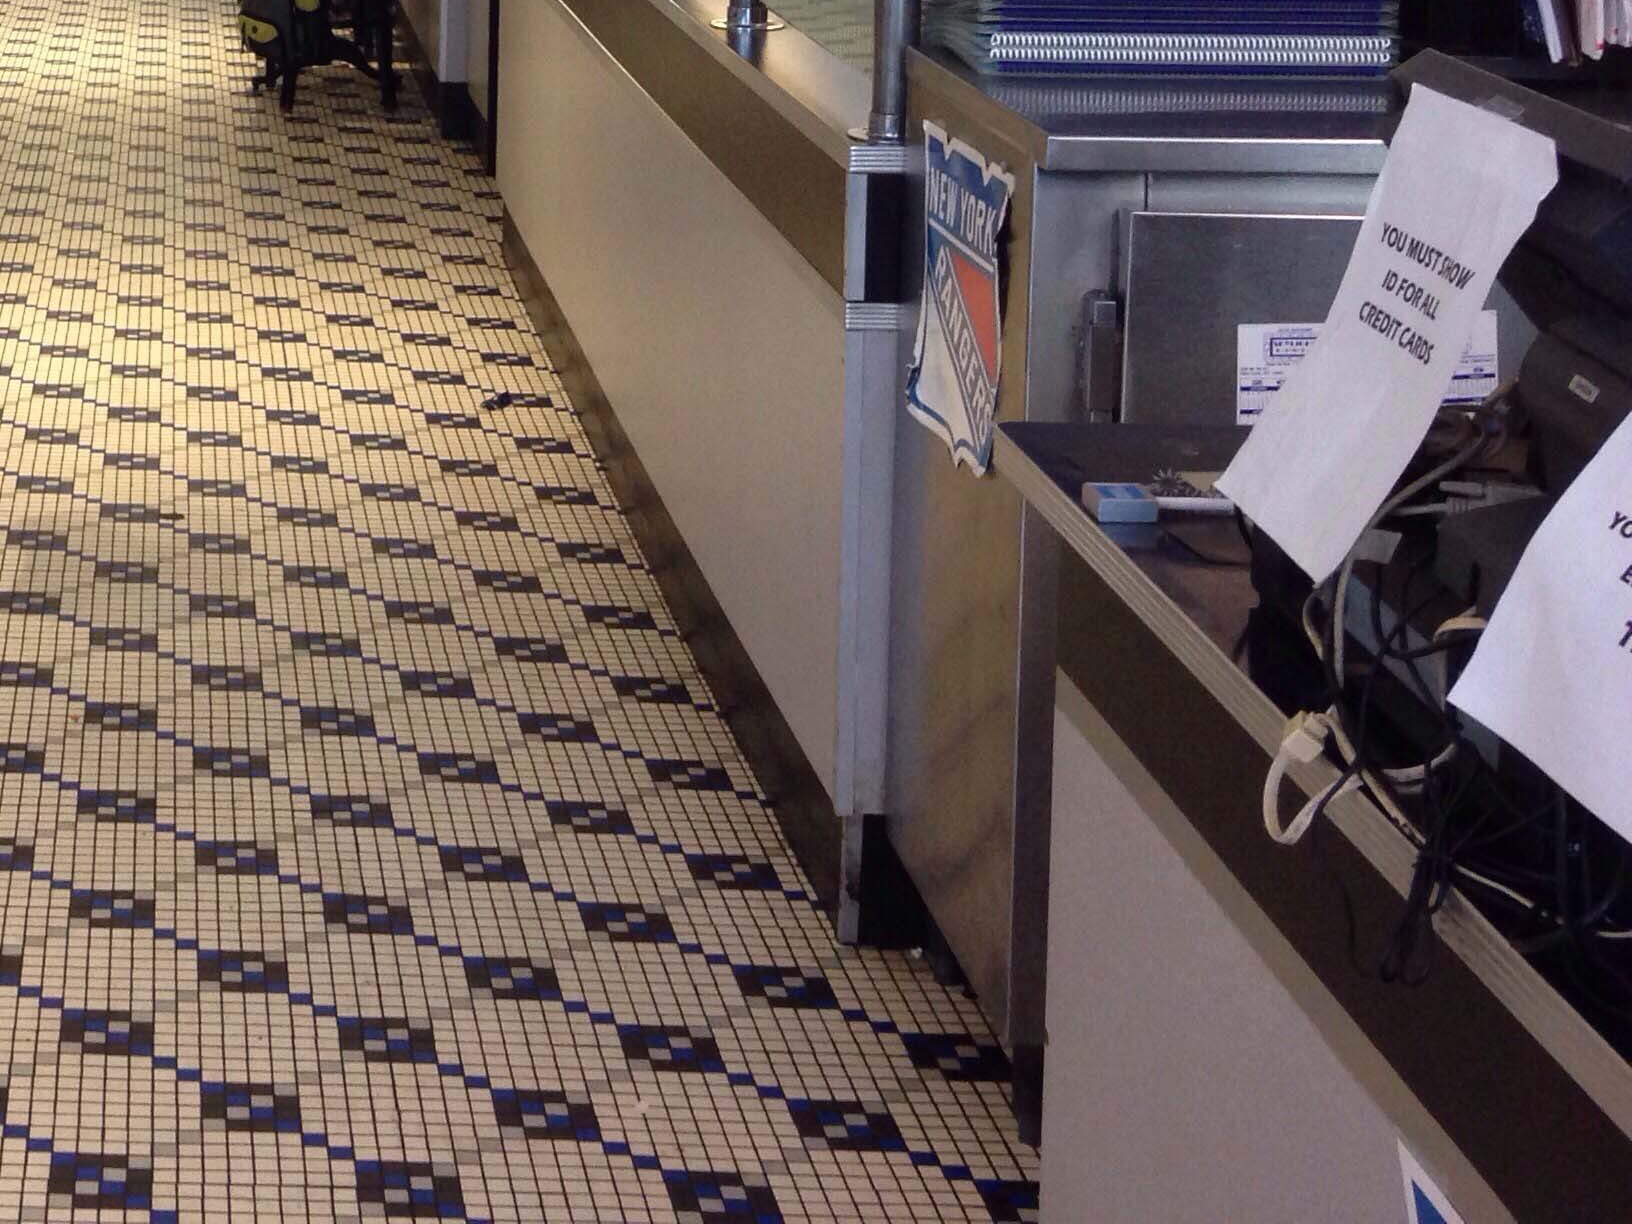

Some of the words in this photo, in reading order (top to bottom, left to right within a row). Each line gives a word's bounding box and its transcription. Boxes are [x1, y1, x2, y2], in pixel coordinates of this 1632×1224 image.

[929, 167, 957, 226] NEW
[960, 187, 998, 258] YORK
[1381, 222, 1408, 253] YOU
[1406, 237, 1443, 271] MUST
[1437, 256, 1476, 290] SHOW
[1381, 269, 1399, 292] ID
[1395, 278, 1424, 308] FOR
[1419, 293, 1441, 321] ALL
[935, 244, 994, 446] RANGERS
[1359, 301, 1403, 341] CREDIT
[1398, 327, 1435, 365] CARDS
